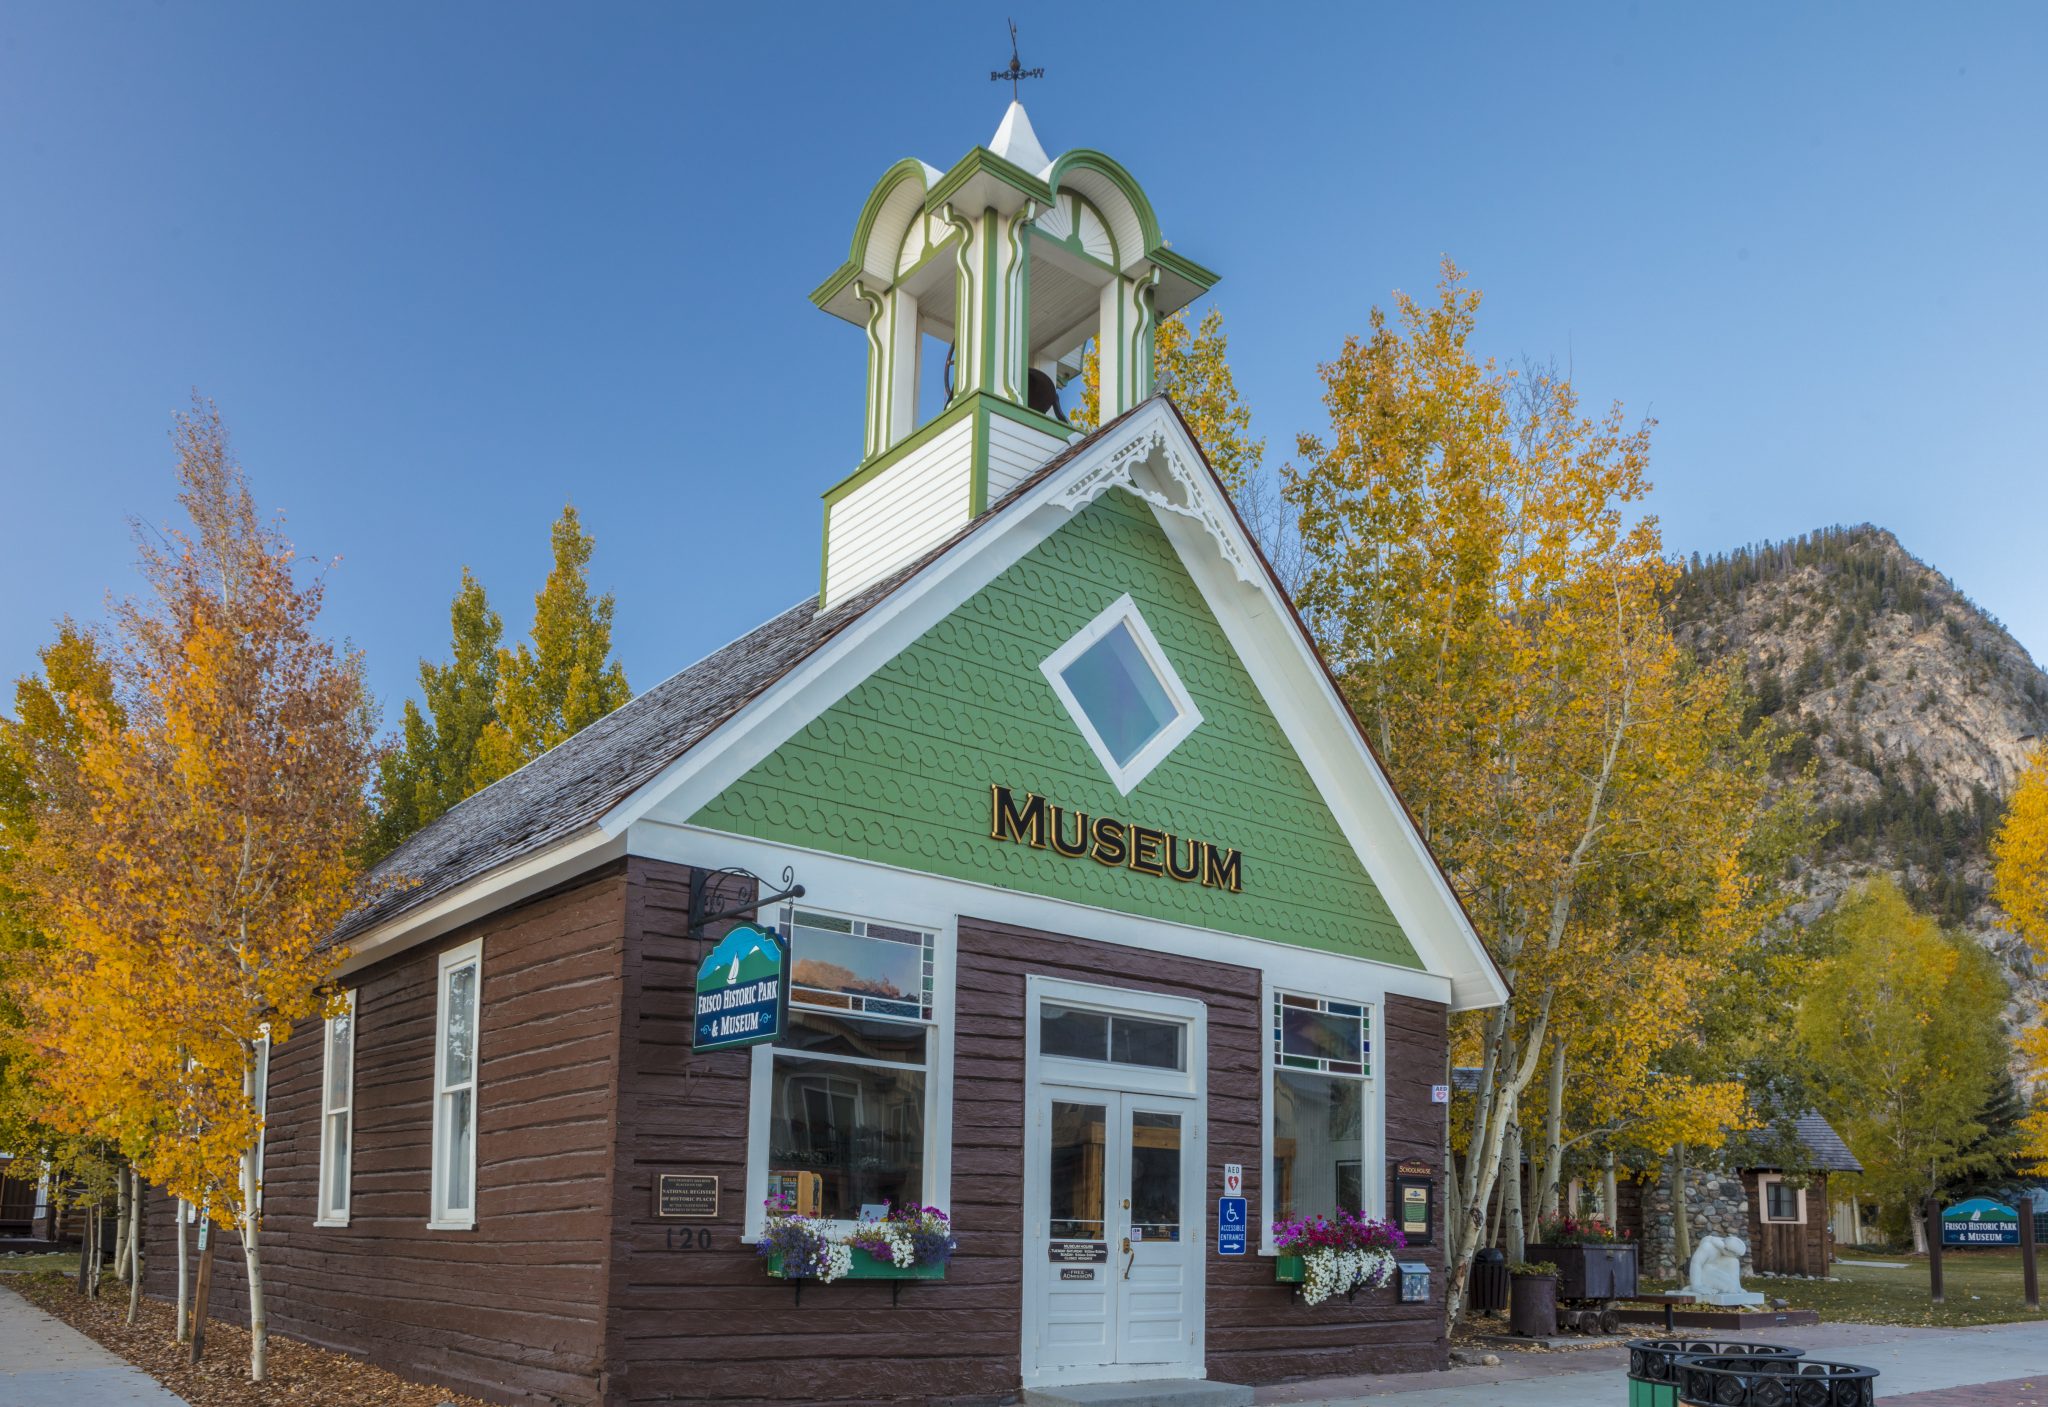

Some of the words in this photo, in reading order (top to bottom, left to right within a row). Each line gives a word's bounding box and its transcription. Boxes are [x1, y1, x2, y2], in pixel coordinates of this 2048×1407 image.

[990, 783, 1243, 893] MUSEUM
[698, 993, 722, 1014] FRISCO
[723, 985, 757, 1009] HISTORIC
[758, 980, 778, 1002] PARK
[711, 1020, 718, 1037] &
[720, 1012, 759, 1035] MUSEUM
[1227, 1166, 1239, 1174] AED
[1399, 1165, 1431, 1174] SCHOOLHOUSE
[1220, 1224, 1245, 1232] ACCESSIBLE
[1945, 1222, 1967, 1231] FRISCO
[1968, 1222, 1999, 1231] HISTORIC
[2000, 1222, 2017, 1231] PARK
[667, 1227, 712, 1249] 120
[1220, 1233, 1245, 1241] ENTRANCE
[1960, 1233, 1966, 1241] &
[1968, 1232, 2003, 1241] MUSEUM
